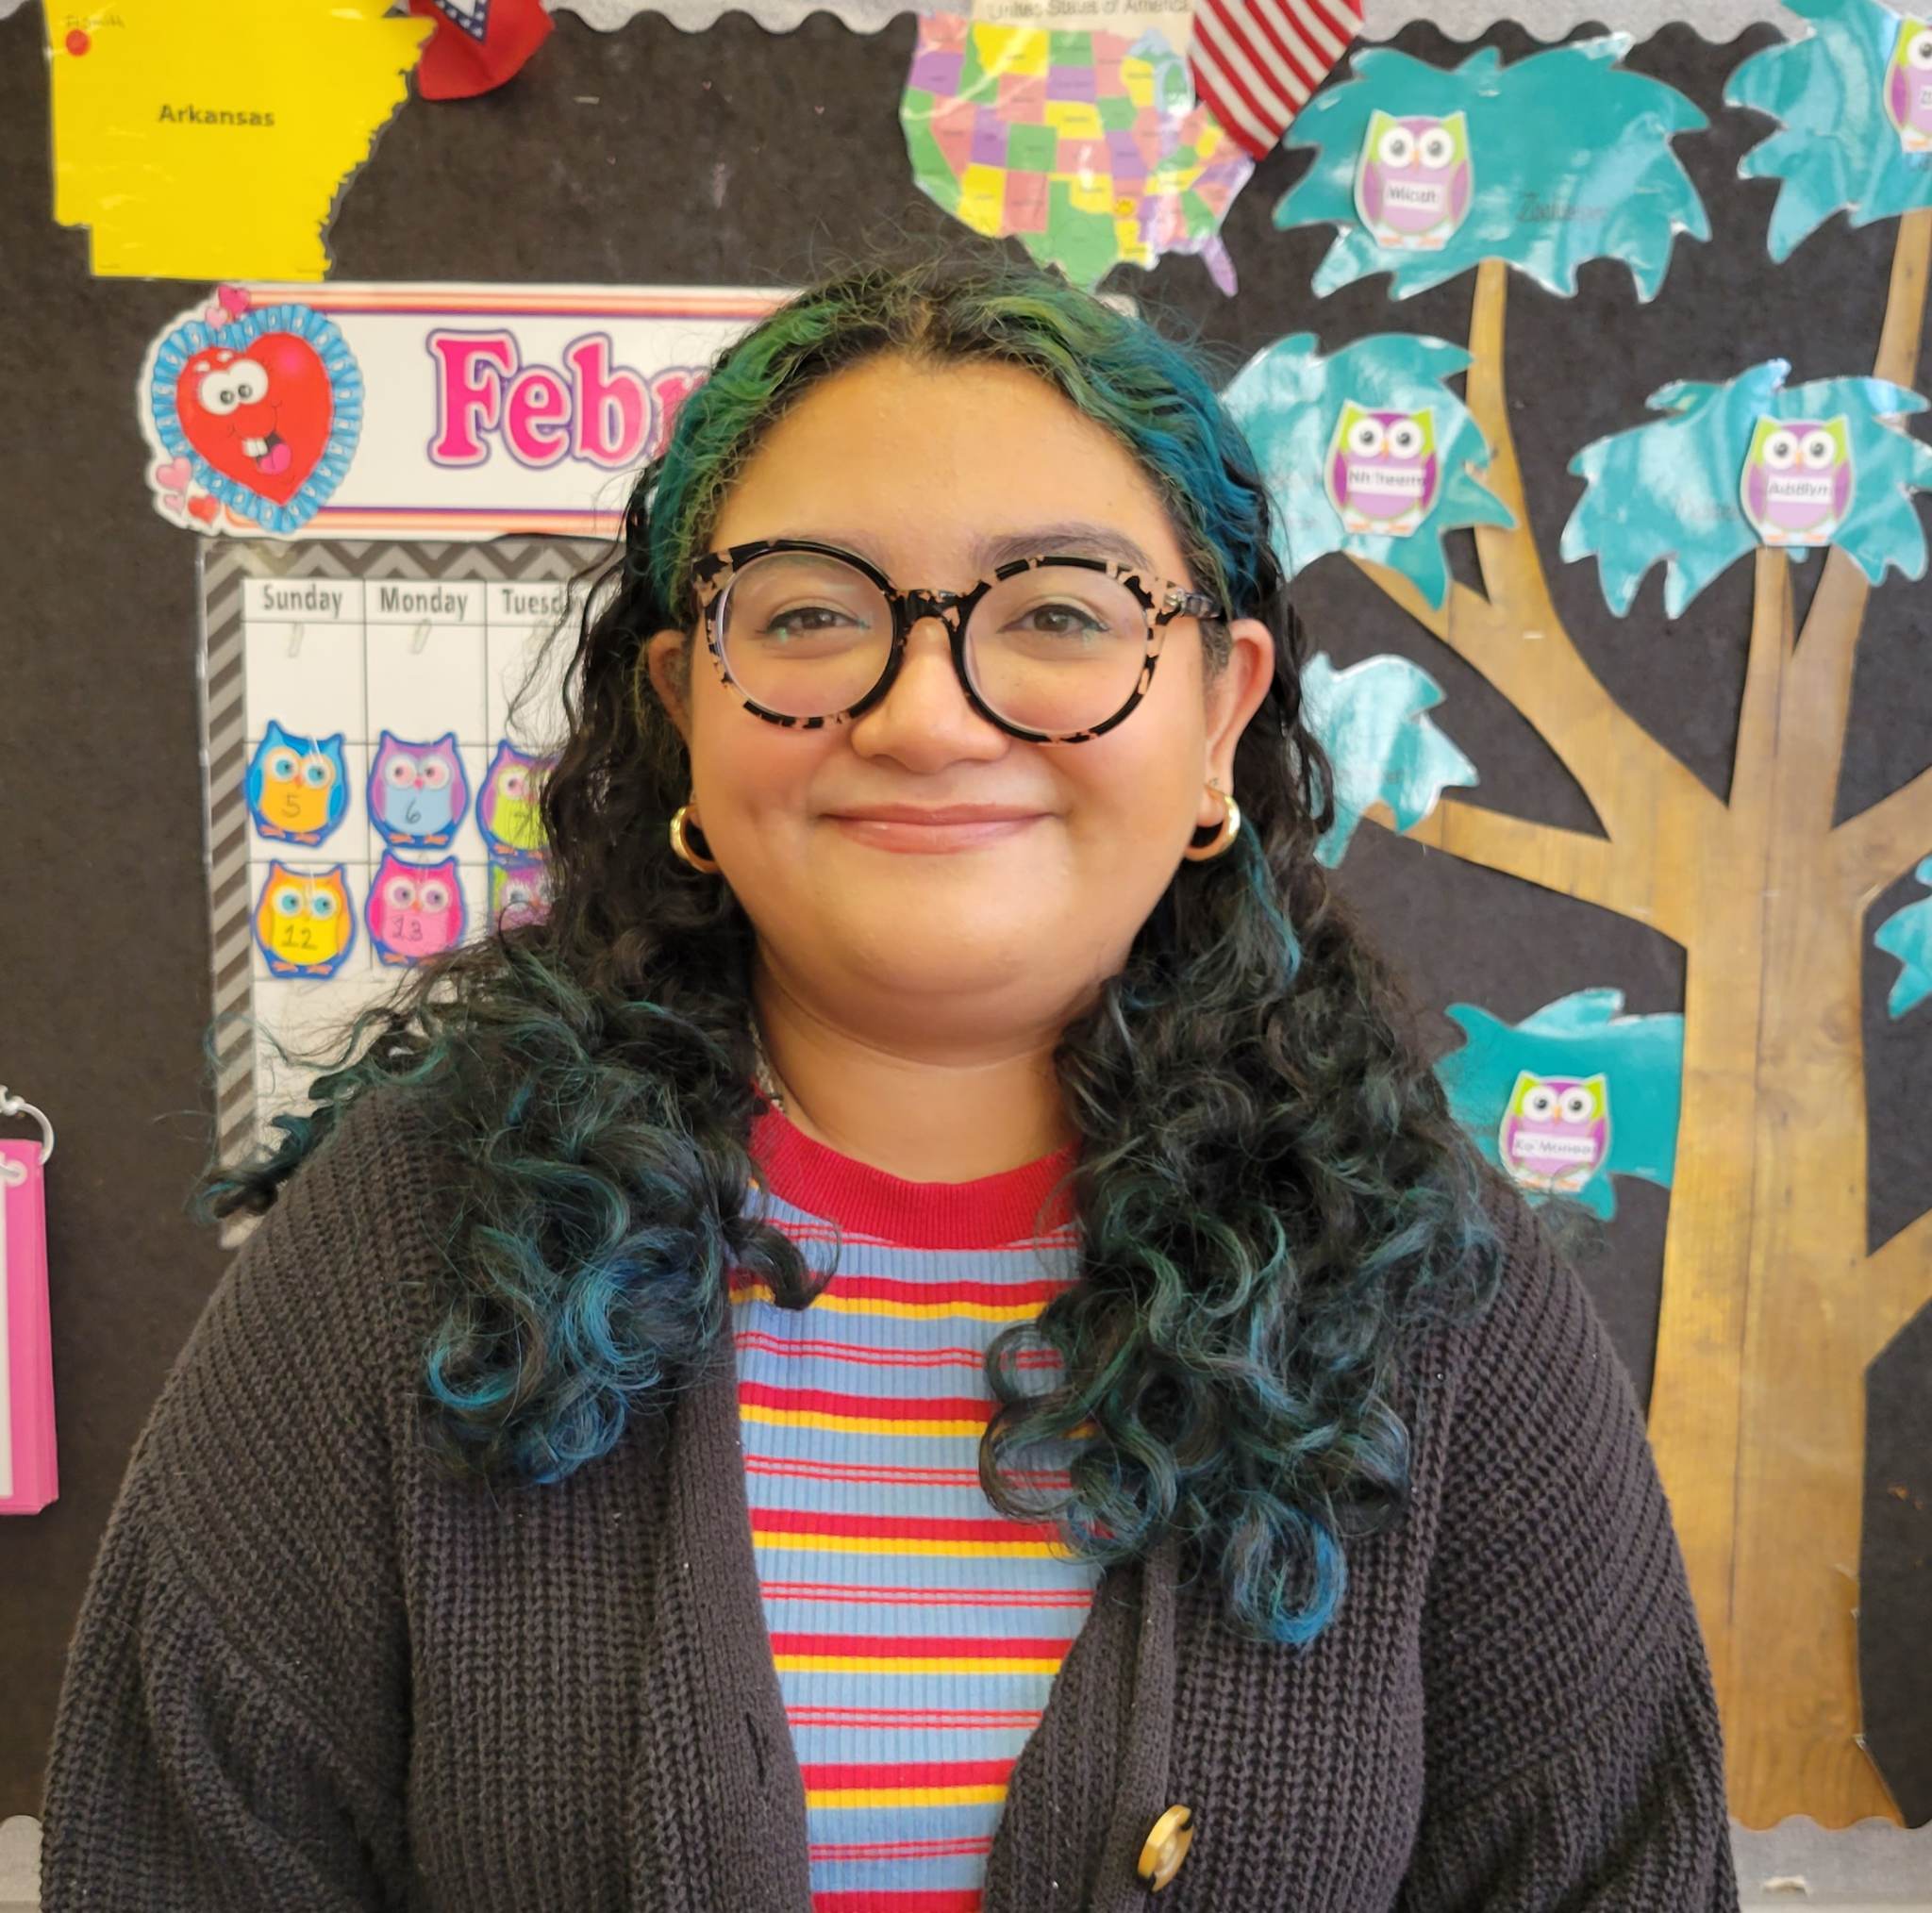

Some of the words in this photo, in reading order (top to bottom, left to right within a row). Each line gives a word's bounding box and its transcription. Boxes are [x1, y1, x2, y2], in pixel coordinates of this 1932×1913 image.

[158, 105, 275, 127] Arkansas
[263, 585, 341, 618] Sunday
[380, 587, 468, 621] Monday
[502, 589, 572, 616] Tuesd
[281, 794, 301, 819] 5
[404, 799, 422, 825] 6
[281, 925, 318, 952] 12
[391, 916, 424, 942] 13
